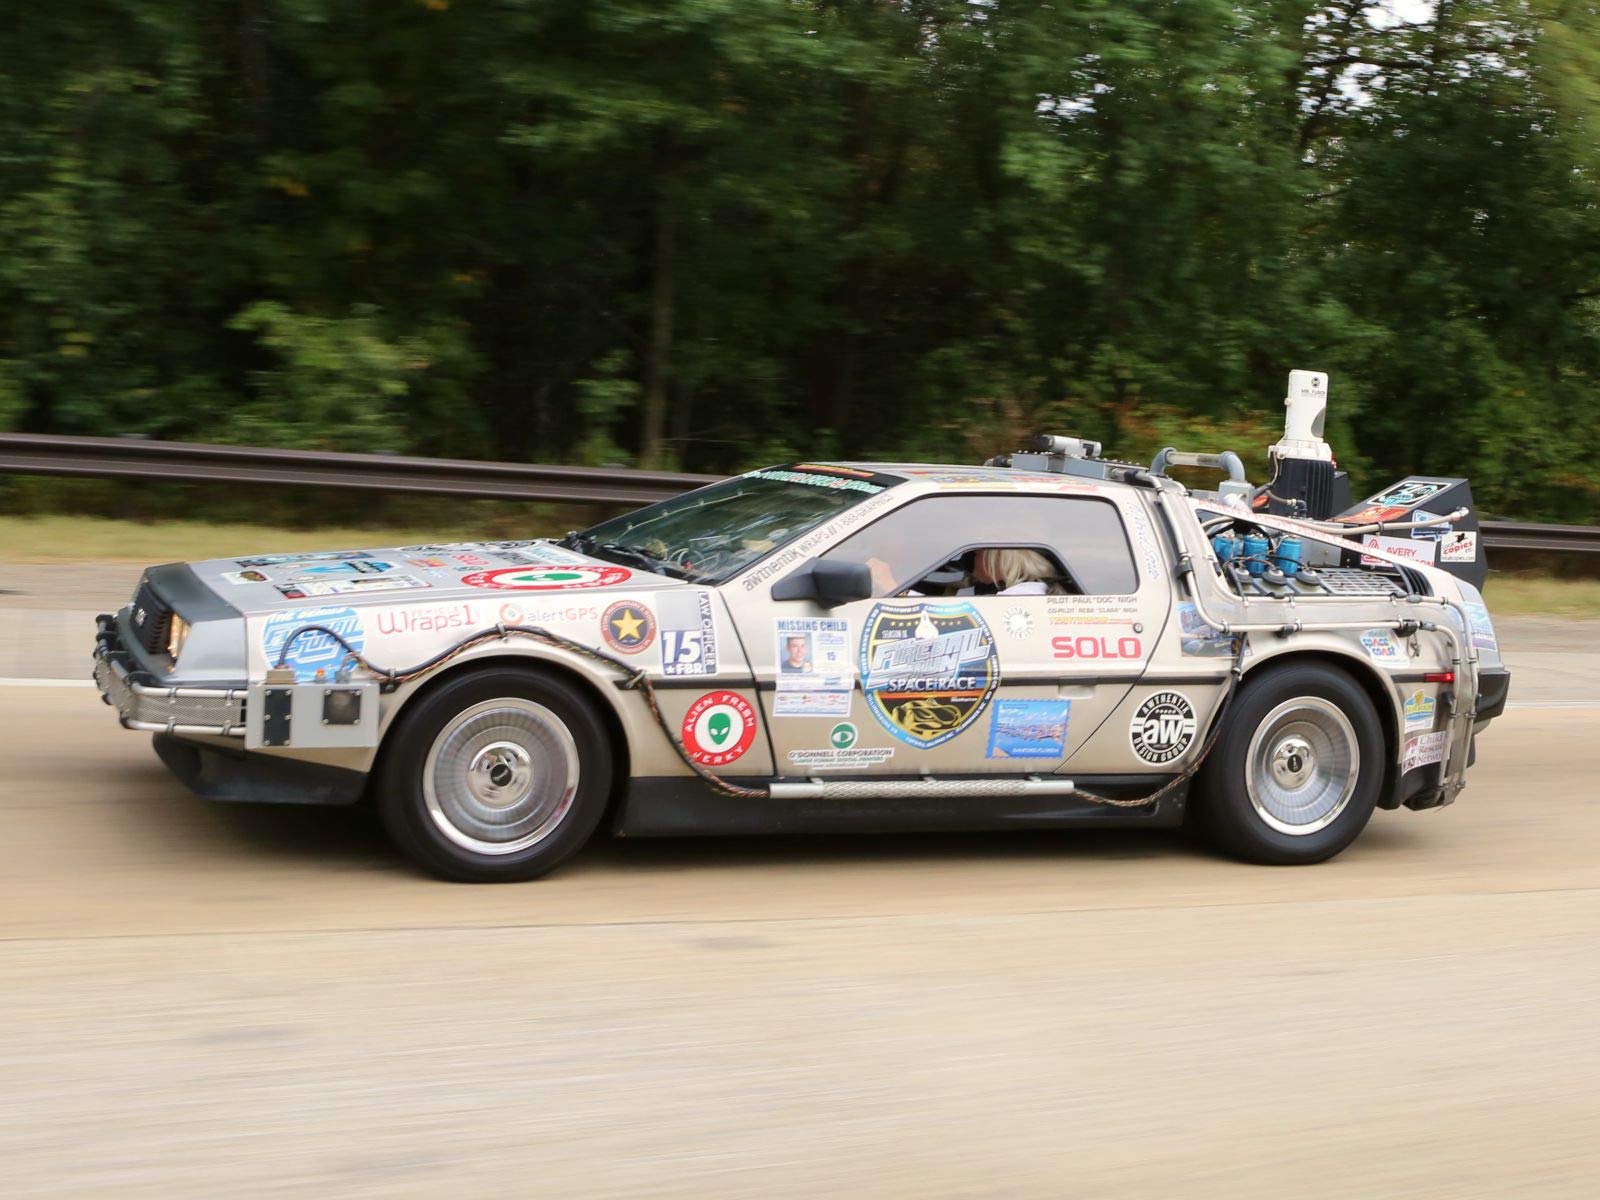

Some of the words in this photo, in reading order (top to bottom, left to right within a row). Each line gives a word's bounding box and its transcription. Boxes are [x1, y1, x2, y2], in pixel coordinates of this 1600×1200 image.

[1386, 546, 1417, 558] AVERY
[742, 548, 806, 591] awthentik
[527, 607, 599, 622] alertGPS
[777, 620, 818, 631] MISSING
[820, 621, 848, 632] CHILD
[662, 631, 702, 664] 15
[703, 617, 716, 666] OFFICER
[873, 628, 990, 672] FIREBALL
[1052, 637, 1142, 658] SOLO
[676, 663, 702, 674] FBR
[888, 678, 933, 692] SPACE
[937, 676, 976, 690] RACE
[685, 697, 714, 732] ALIEN
[722, 694, 755, 727] FRESH
[1141, 693, 1190, 714] AWTHENTIK
[692, 746, 743, 765] JERKY
[836, 749, 893, 757] CORPORATION
[1133, 737, 1159, 762] DESIGN
[1161, 737, 1188, 762] GROUP
